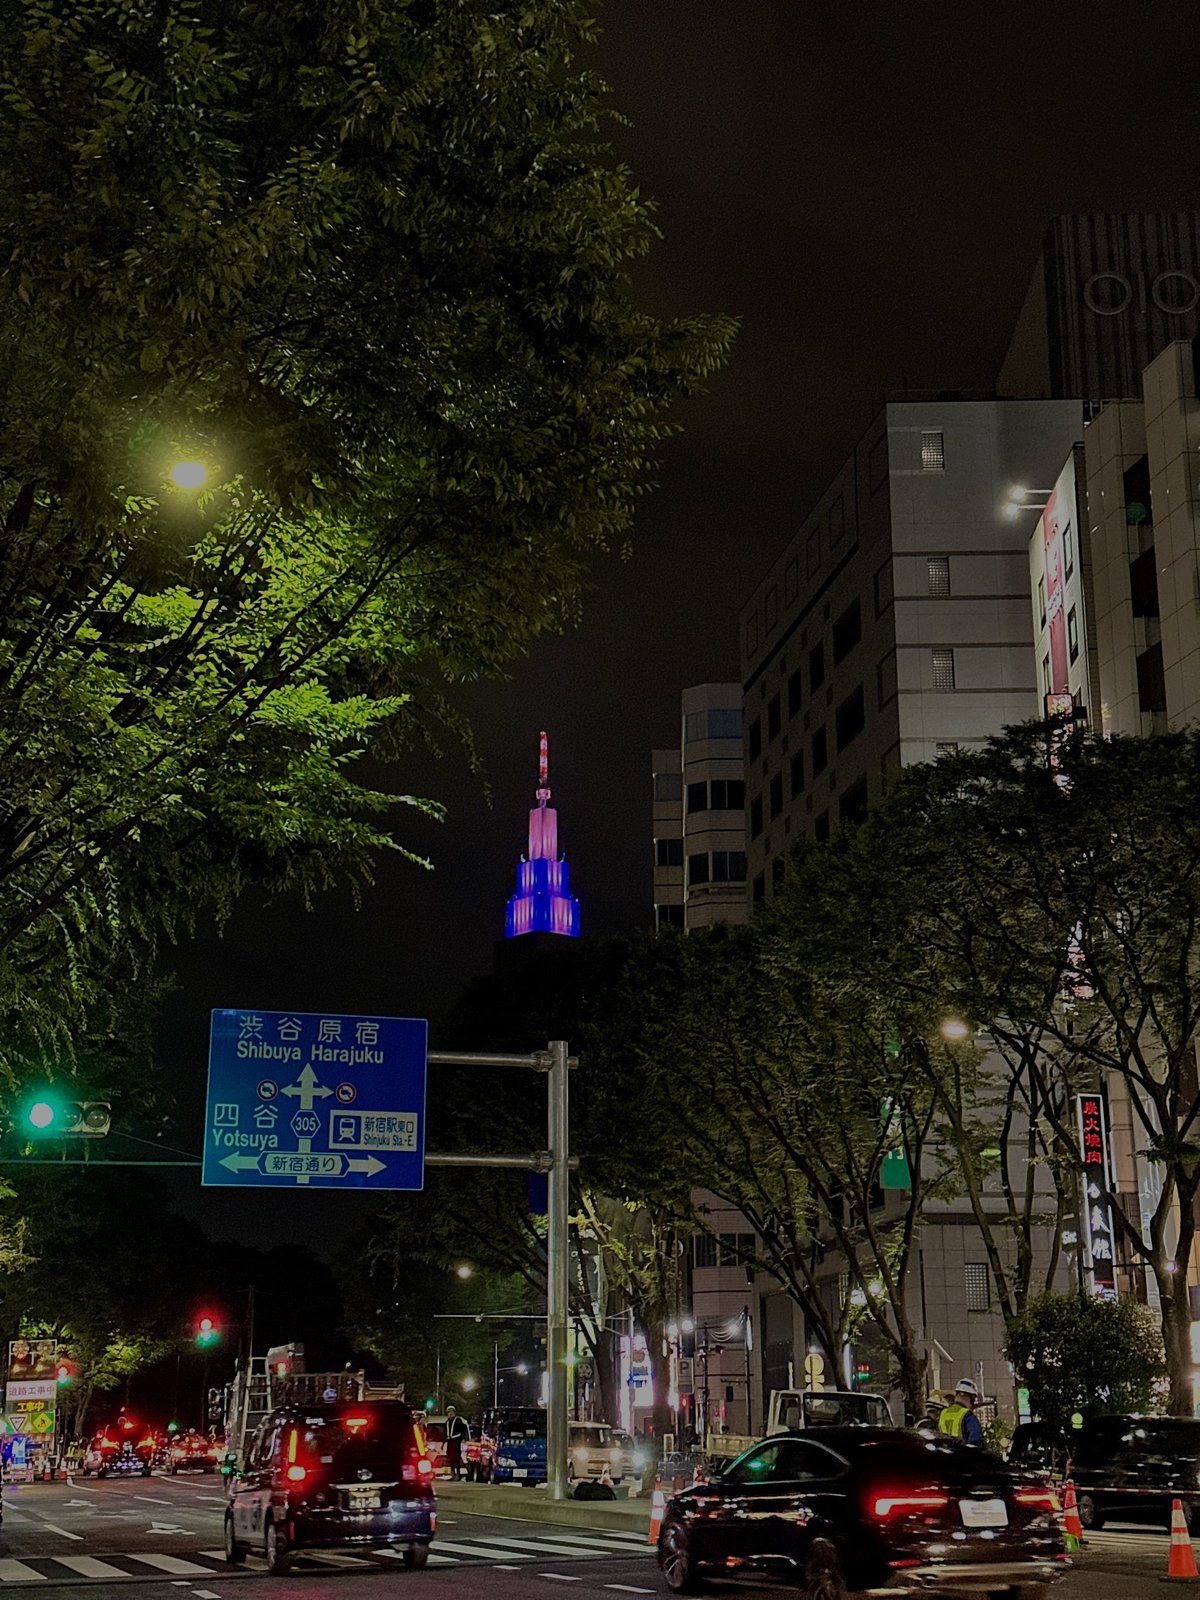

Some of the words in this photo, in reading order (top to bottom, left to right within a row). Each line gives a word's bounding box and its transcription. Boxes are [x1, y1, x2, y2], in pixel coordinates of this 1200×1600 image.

[236, 1040, 301, 1063] Shibuya
[311, 1043, 384, 1066] Harajuku
[213, 1103, 278, 1129] 四谷
[295, 1118, 316, 1132] 305
[212, 1128, 278, 1151] Yotsuya
[363, 1133, 390, 1148] Shinjuku
[272, 1156, 335, 1172] 新宿通り
